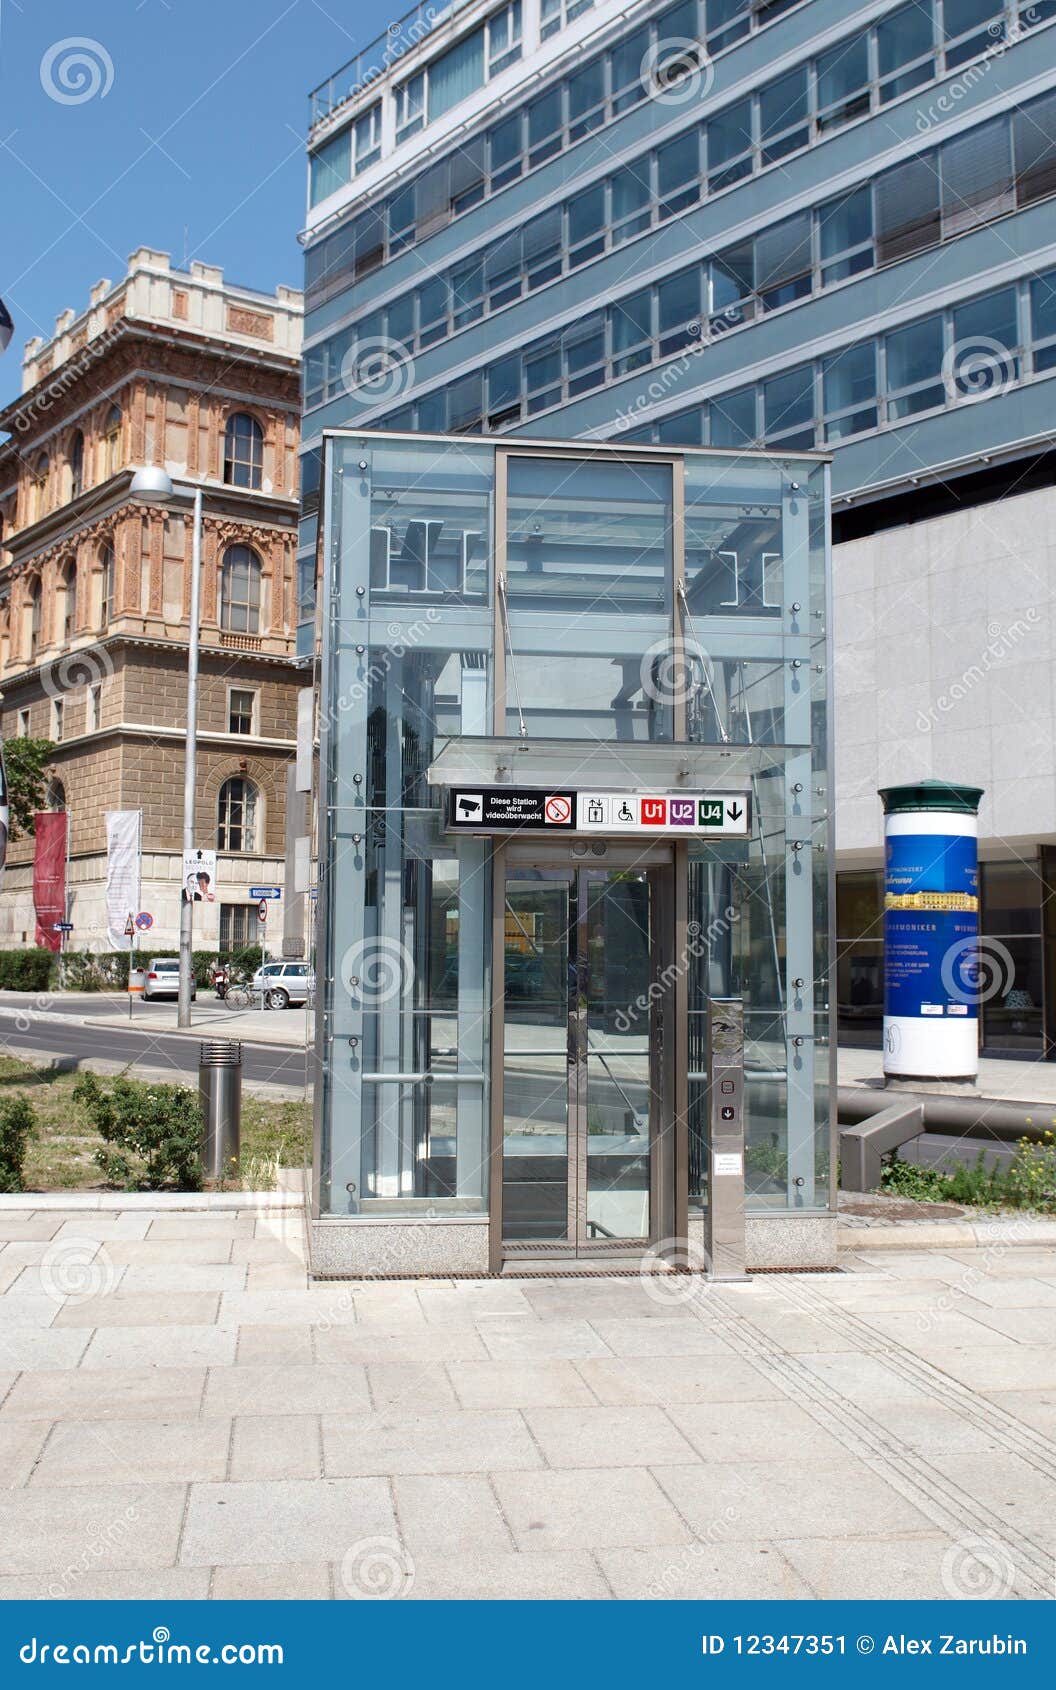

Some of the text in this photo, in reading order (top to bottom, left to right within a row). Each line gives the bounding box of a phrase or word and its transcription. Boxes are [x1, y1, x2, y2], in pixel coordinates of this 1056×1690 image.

[490, 797, 538, 806] Diese Station
[485, 811, 542, 820] videoüberwacht
[644, 803, 722, 820] U1 U2 U4
